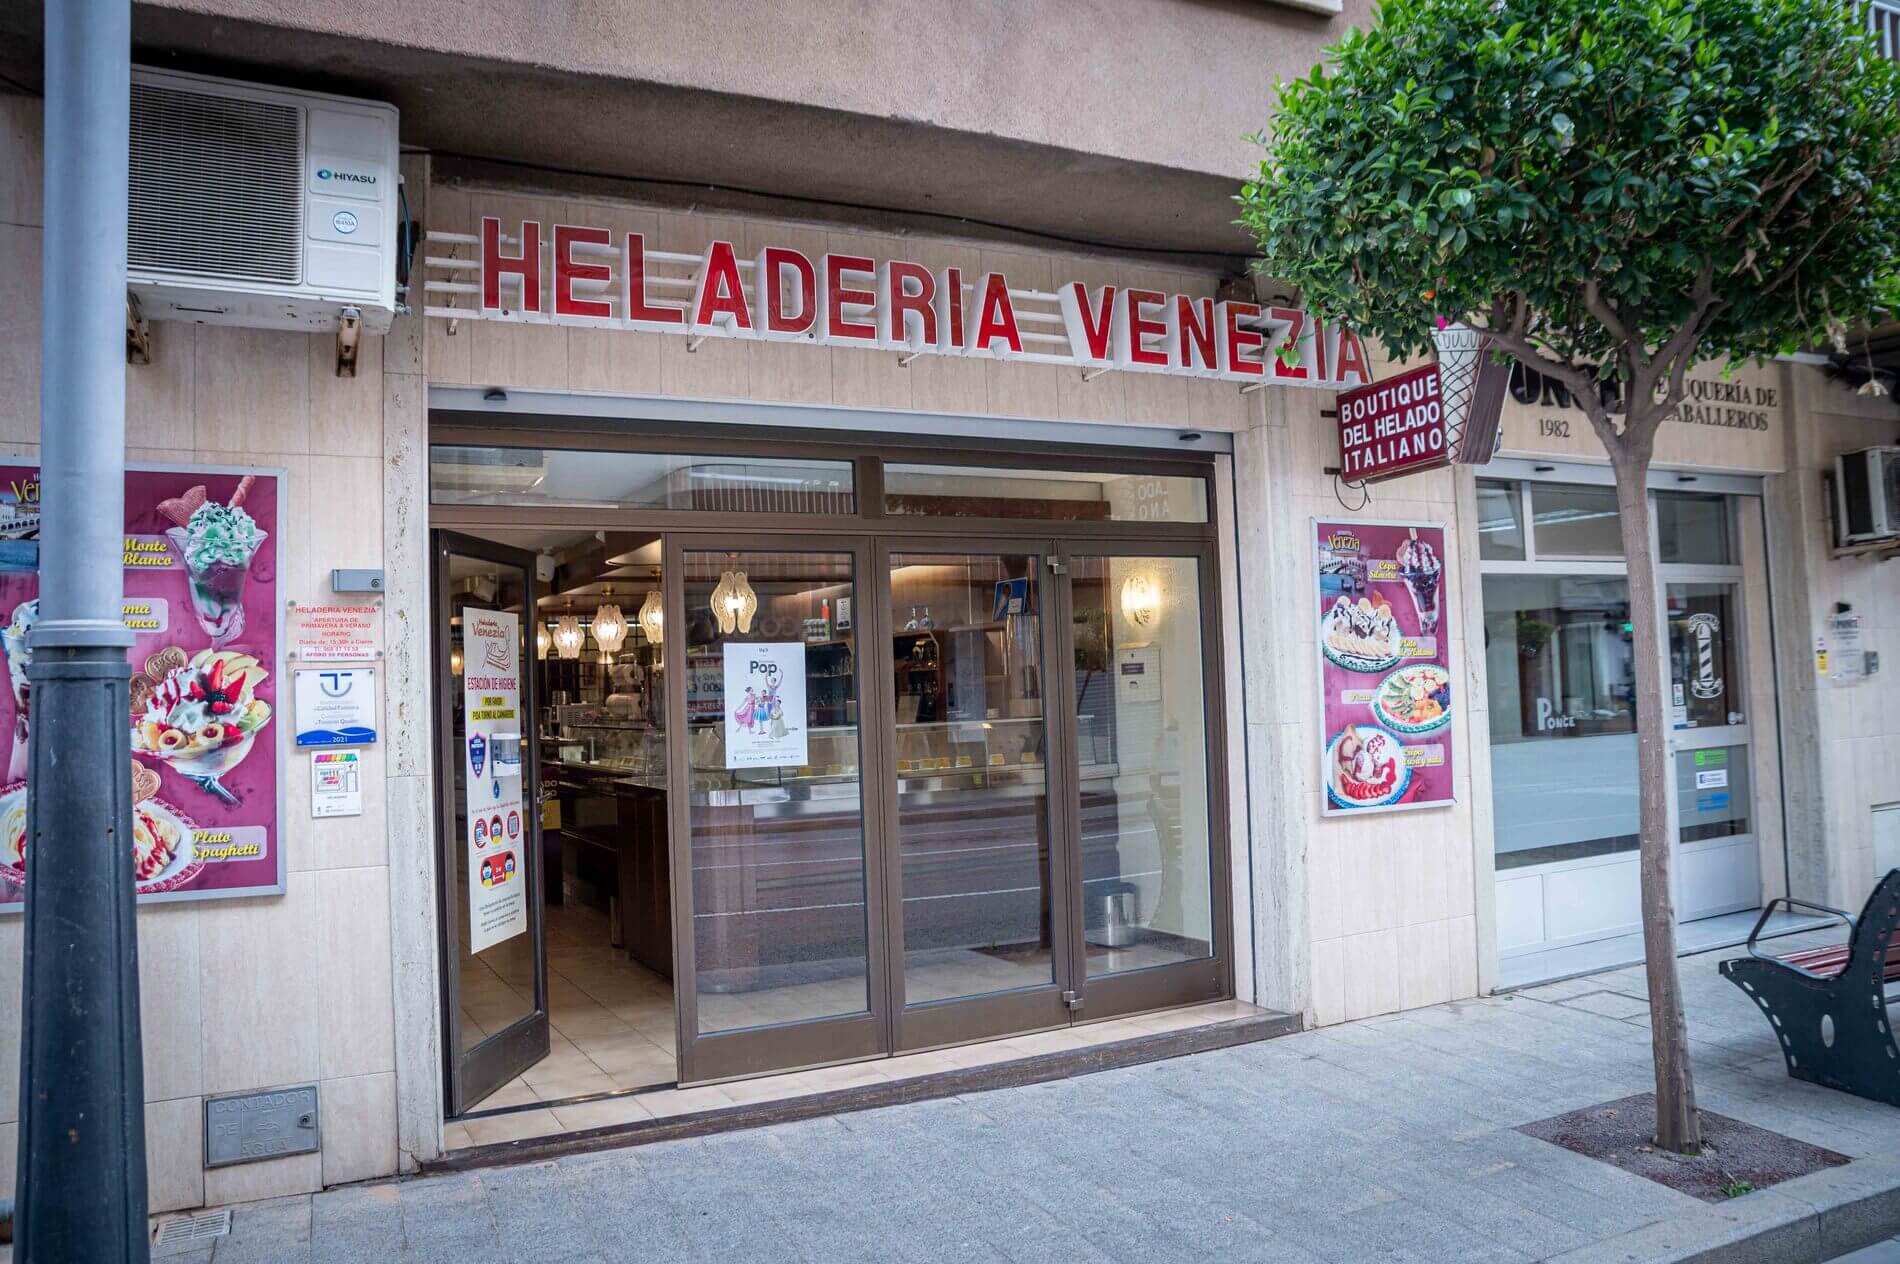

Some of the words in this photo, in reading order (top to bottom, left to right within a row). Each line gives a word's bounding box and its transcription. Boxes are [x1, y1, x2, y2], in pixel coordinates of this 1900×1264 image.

[333, 171, 377, 184] HIYASU
[481, 216, 1024, 353] HELADERIA
[1070, 281, 1369, 385] VENEZIA
[1341, 374, 1439, 424] BOUTIQUE
[1755, 387, 1778, 408] DE
[1343, 422, 1372, 448] DEL
[1374, 401, 1441, 440] HELADO
[1665, 403, 1769, 431] ABALLEROS
[1539, 418, 1571, 438] 1982
[1343, 428, 1443, 473] ITALIANO
[124, 538, 168, 552] Monte
[123, 552, 173, 566] Blanco
[471, 622, 505, 638] Venezia
[749, 660, 777, 677] Pop
[193, 831, 232, 844] Plato
[191, 843, 260, 862] Spaghetti
